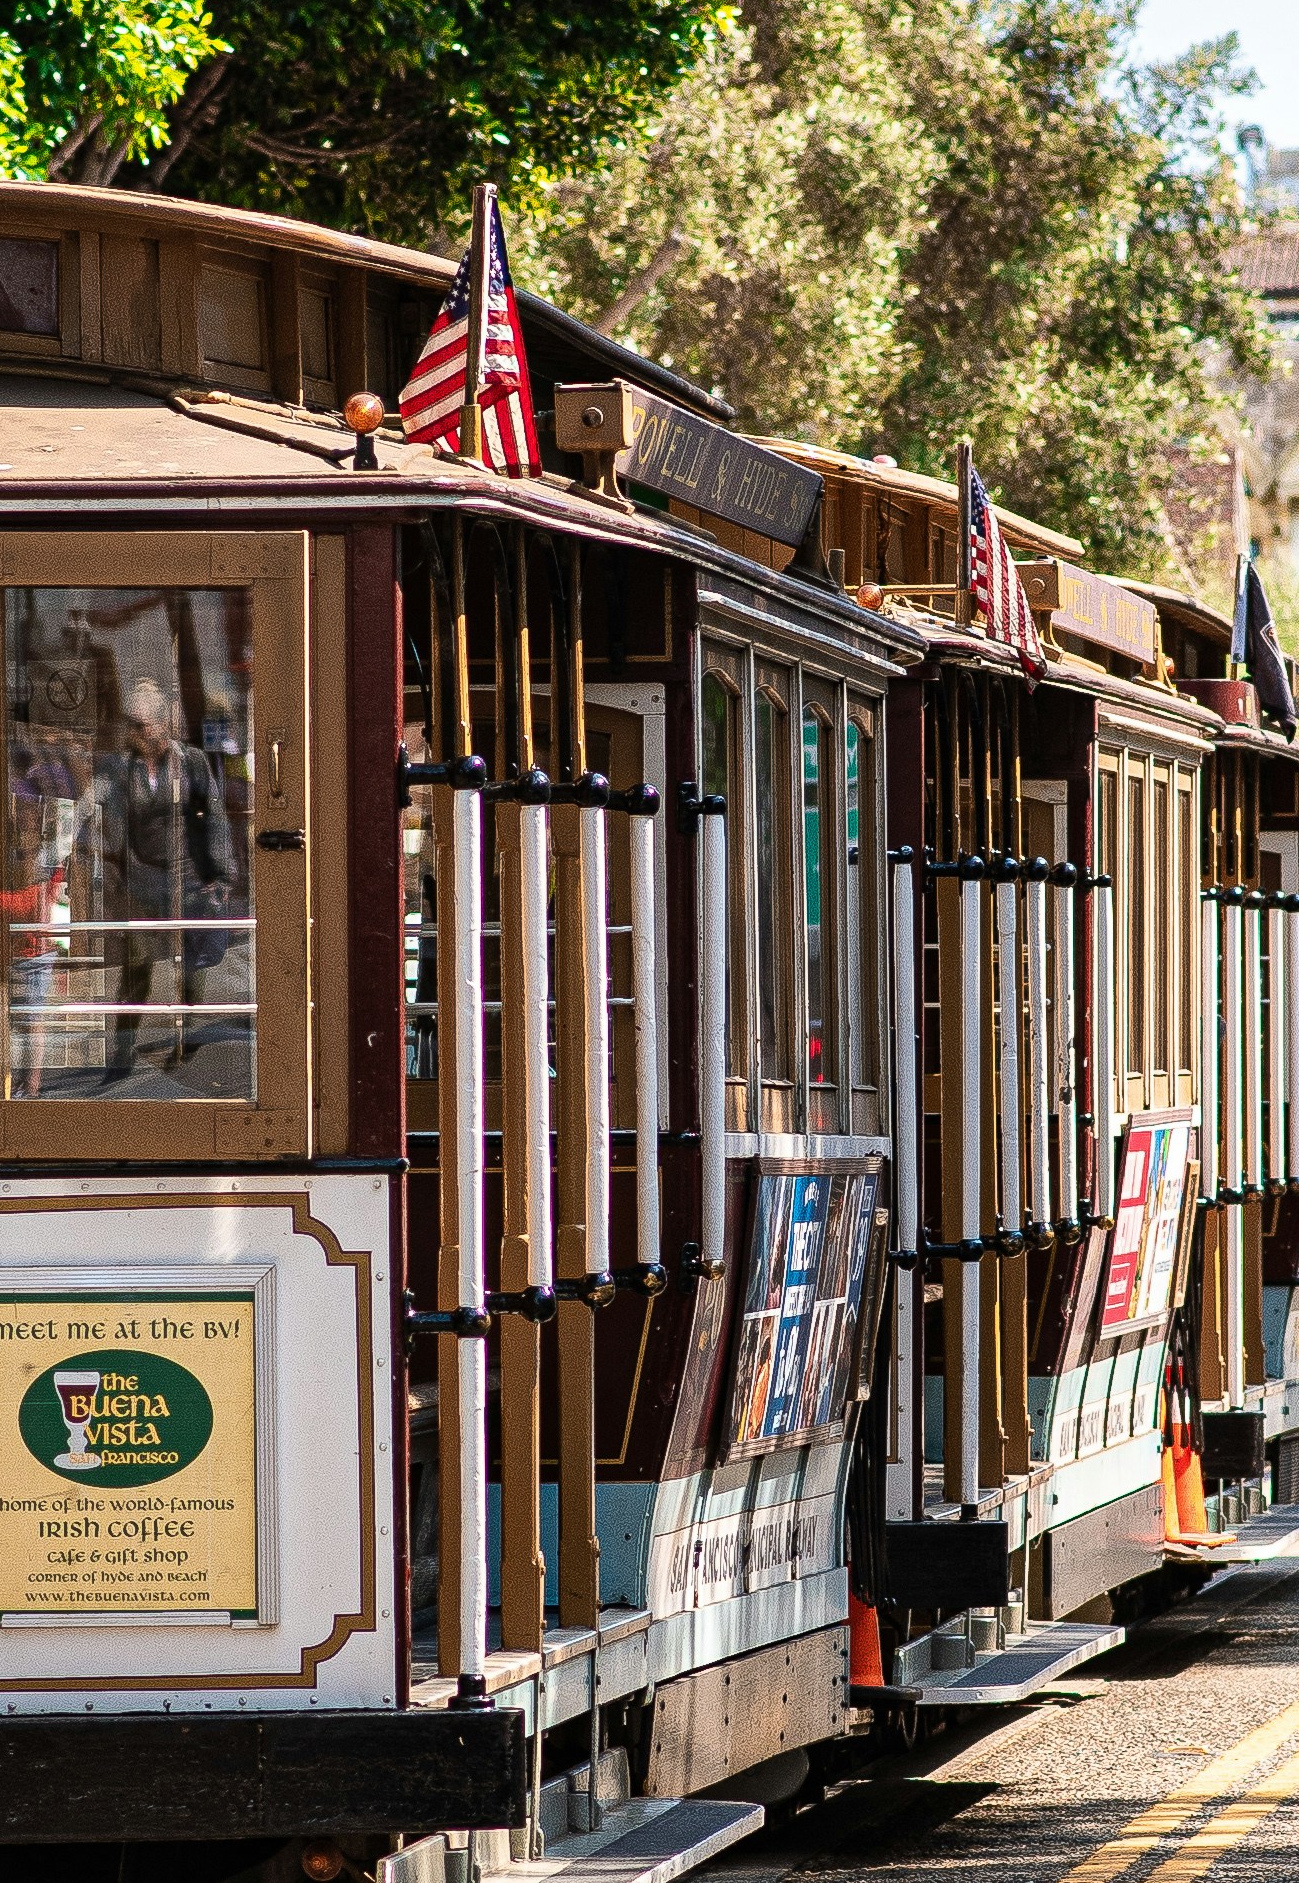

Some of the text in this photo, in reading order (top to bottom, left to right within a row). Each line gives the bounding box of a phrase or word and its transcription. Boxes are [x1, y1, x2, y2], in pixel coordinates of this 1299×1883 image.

[619, 406, 704, 489] POWELL
[734, 459, 789, 520] HYDE
[90, 1550, 102, 1563] &
